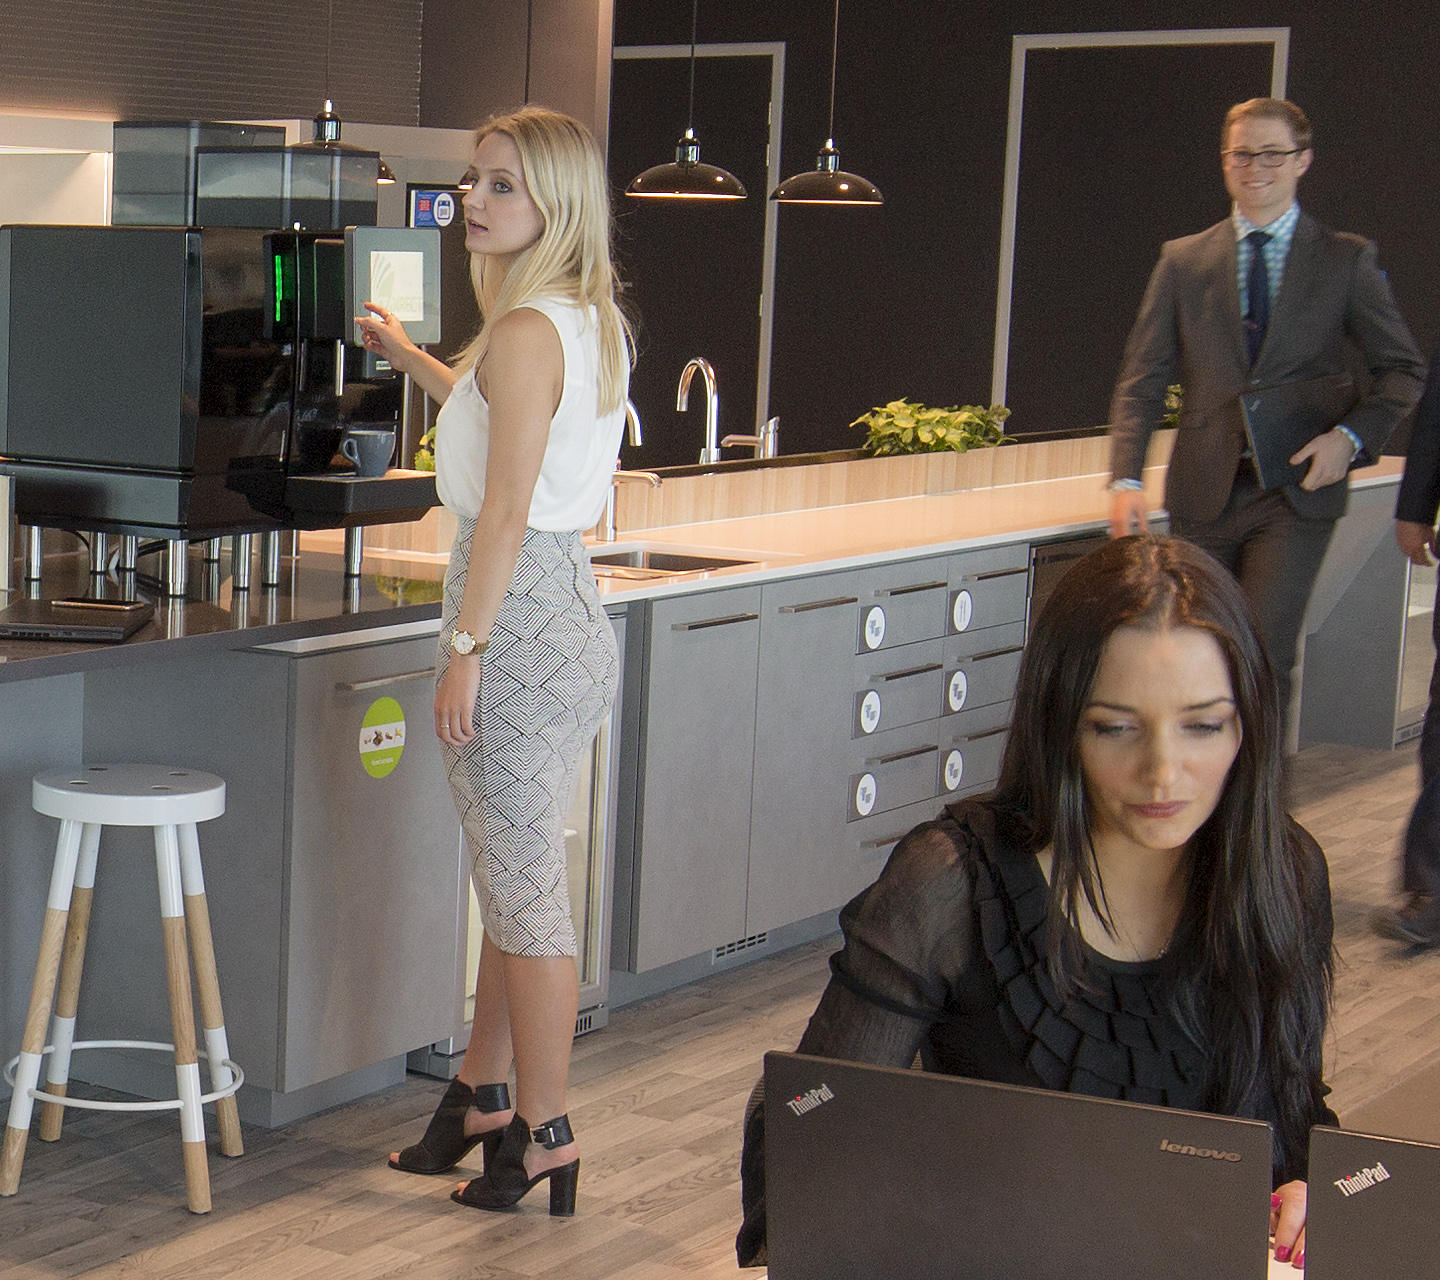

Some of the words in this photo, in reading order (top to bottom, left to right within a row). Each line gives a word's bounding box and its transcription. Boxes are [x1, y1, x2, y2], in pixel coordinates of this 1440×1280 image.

[786, 1083, 836, 1116] ThinkPad
[1160, 1139, 1241, 1162] lenovo
[1333, 1161, 1391, 1197] ThinkPad
